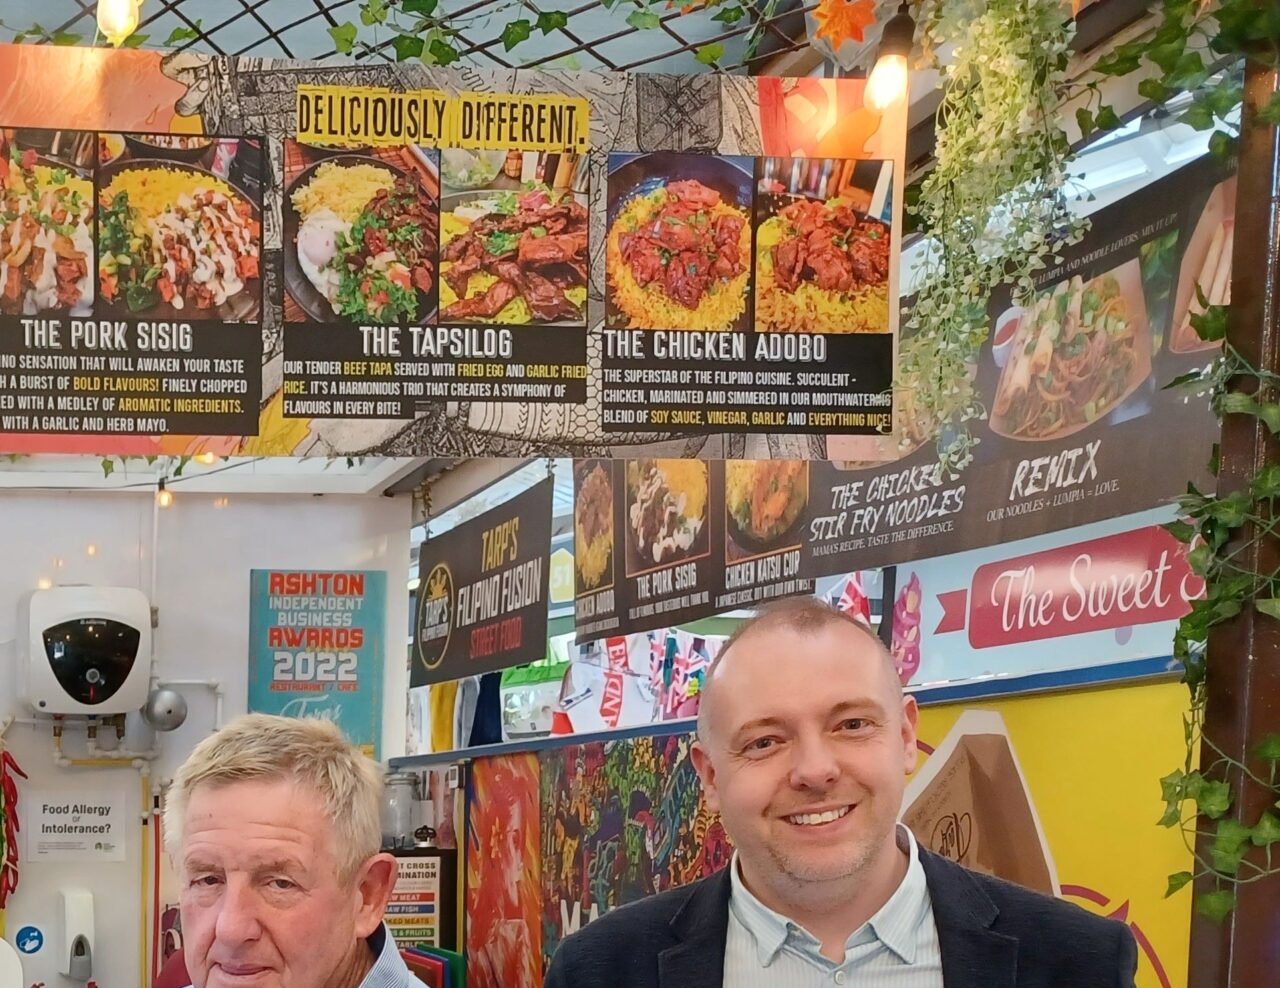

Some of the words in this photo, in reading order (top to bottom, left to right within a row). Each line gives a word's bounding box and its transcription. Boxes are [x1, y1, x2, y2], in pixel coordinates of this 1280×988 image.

[299, 95, 446, 140] DELICIOUSLY
[462, 101, 585, 145] DIFFERENT.
[20, 319, 62, 349] THE
[70, 321, 127, 350] PORK
[137, 322, 193, 351] SISIG
[359, 325, 401, 357] THE
[409, 327, 513, 358] TAPSILOG
[604, 330, 644, 359] THE
[653, 331, 746, 361] CHICKEN
[755, 334, 827, 362] ADOBO
[19, 355, 77, 370] SENSATION
[80, 356, 106, 371] THAT
[109, 357, 134, 371] WILL
[137, 358, 180, 372] AWAKEN
[184, 359, 211, 372] YOUR
[214, 360, 244, 373] TASTE
[284, 361, 302, 374] OUR
[305, 362, 342, 375] TENDER
[344, 362, 367, 375] BEEF
[369, 363, 392, 376] TAPA
[394, 363, 429, 376] SERVED
[432, 364, 456, 376] WITH
[458, 364, 484, 377] FRIED
[486, 364, 504, 377] EGG
[506, 365, 524, 377] AND
[526, 364, 559, 378] GARLIC
[562, 365, 586, 379] FRIED
[604, 369, 622, 383] THE
[624, 370, 678, 384] SUPERSTAR
[680, 371, 692, 384] OF
[694, 371, 712, 384] THE
[715, 372, 753, 385] FILIPINO
[755, 373, 794, 386] CUISINE.
[797, 373, 849, 387] SUCCULENT
[284, 401, 331, 415] FLAVOURS
[334, 402, 343, 415] IN
[346, 402, 375, 415] EVERY
[377, 402, 400, 415] BITE!
[1009, 440, 1102, 500] REMIX
[831, 481, 862, 509] THE
[987, 510, 1003, 521] OUR
[1005, 500, 1044, 518] NOODLES
[1053, 491, 1084, 508] LUMPIA
[809, 517, 844, 543] STIR
[850, 510, 880, 535] FRY
[885, 486, 966, 529] NOODLES
[482, 516, 519, 573] TARP'S
[812, 544, 838, 556] MAMA'S
[867, 534, 890, 547] TASTE
[891, 530, 906, 543] THE
[269, 573, 364, 596] ASHTON
[637, 578, 650, 599] THE
[653, 572, 673, 594] PORK
[675, 563, 697, 588] SISIG
[725, 563, 755, 589] CHICKEN
[757, 557, 780, 582] KATSU
[269, 597, 363, 610] INDEPENDENT
[456, 573, 499, 628] FILIPINO
[501, 557, 542, 614] FUSION
[991, 564, 1055, 633] The
[1062, 549, 1172, 622] Sweet
[278, 612, 352, 626] BUSINESS
[269, 628, 363, 648] AWARDS
[471, 622, 497, 659] STREET
[500, 617, 523, 650] FOOD
[273, 651, 358, 681] 2022
[42, 804, 69, 814] Food
[72, 804, 111, 816] Allergy
[42, 824, 111, 834] Intolerance?
